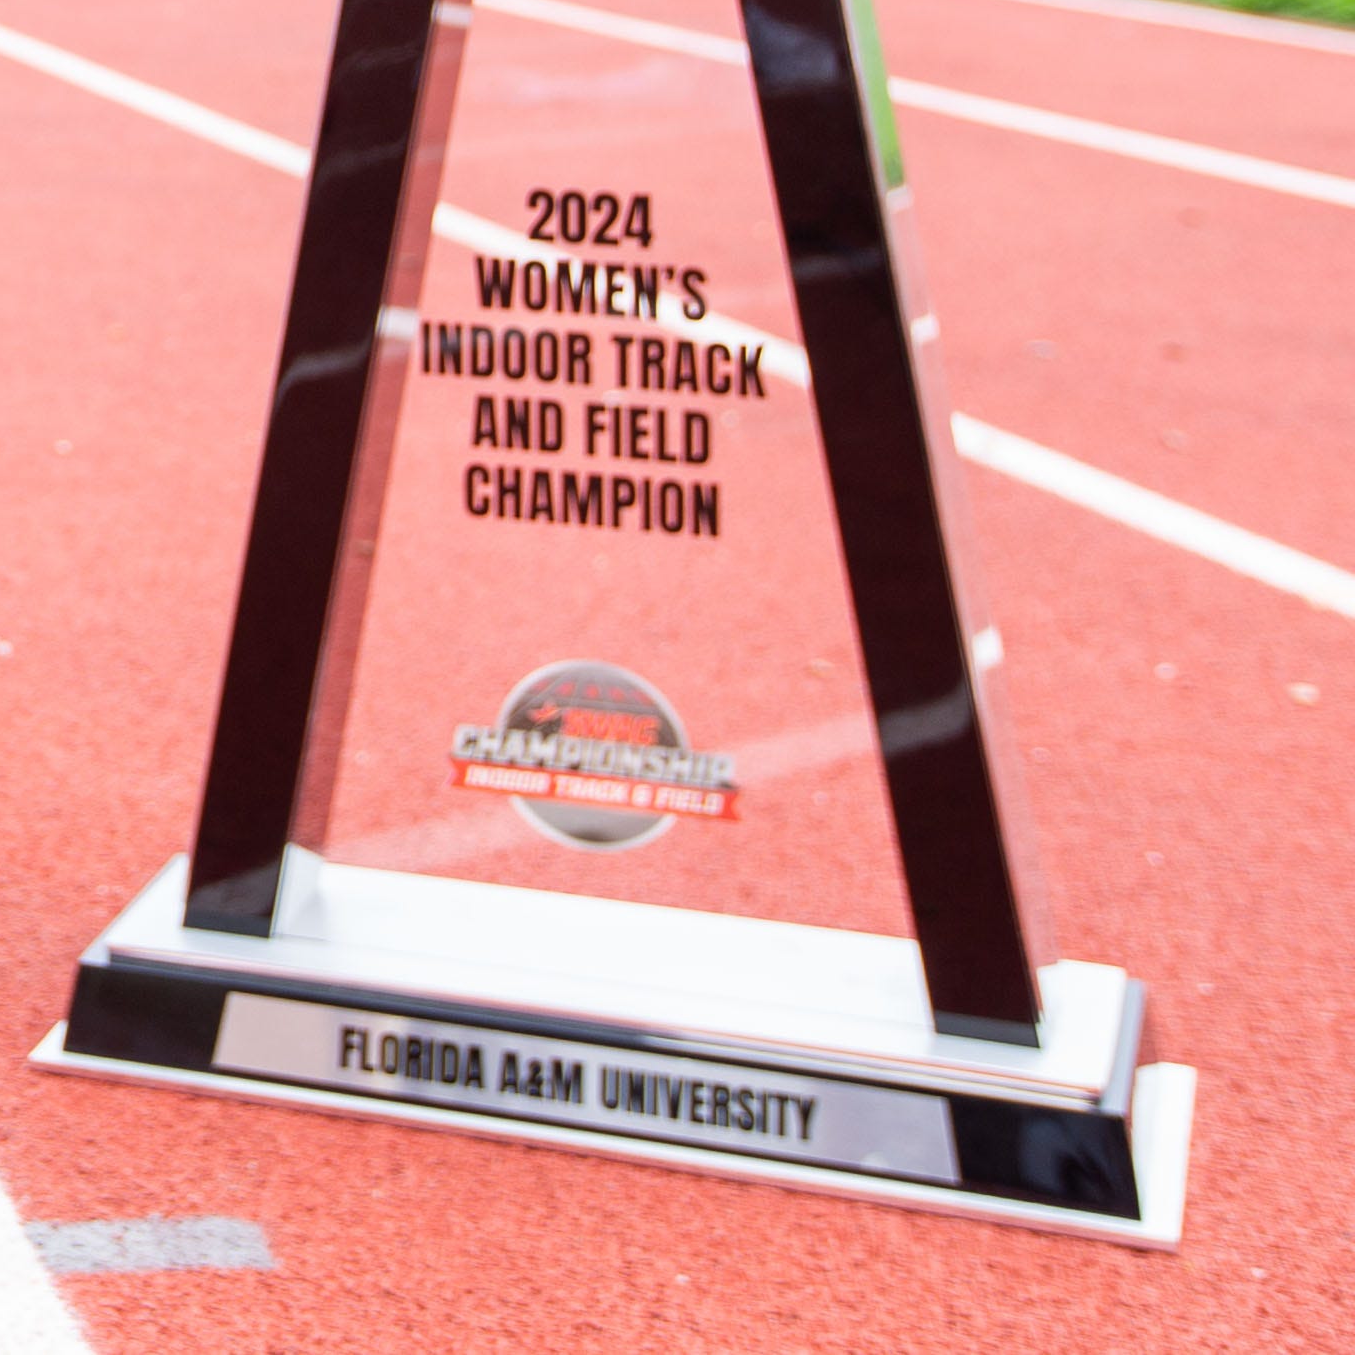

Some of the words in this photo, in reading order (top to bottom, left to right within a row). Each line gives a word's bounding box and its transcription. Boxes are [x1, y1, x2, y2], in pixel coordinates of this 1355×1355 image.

[527, 190, 653, 248] 2024
[475, 255, 709, 322] WOMEN'S
[419, 322, 593, 386] INDOOR
[612, 335, 768, 399] TRACK
[471, 396, 564, 453] AND
[585, 403, 711, 466] FIELD
[463, 464, 721, 537] CHAMPION
[453, 724, 735, 789] CHAMPIONSHIP
[554, 773, 631, 805] TRACK
[654, 785, 725, 816] FIELD
[338, 1025, 485, 1091] FLORIDA
[498, 1050, 584, 1106] A&M
[599, 1066, 817, 1142] UNIVERSITY
